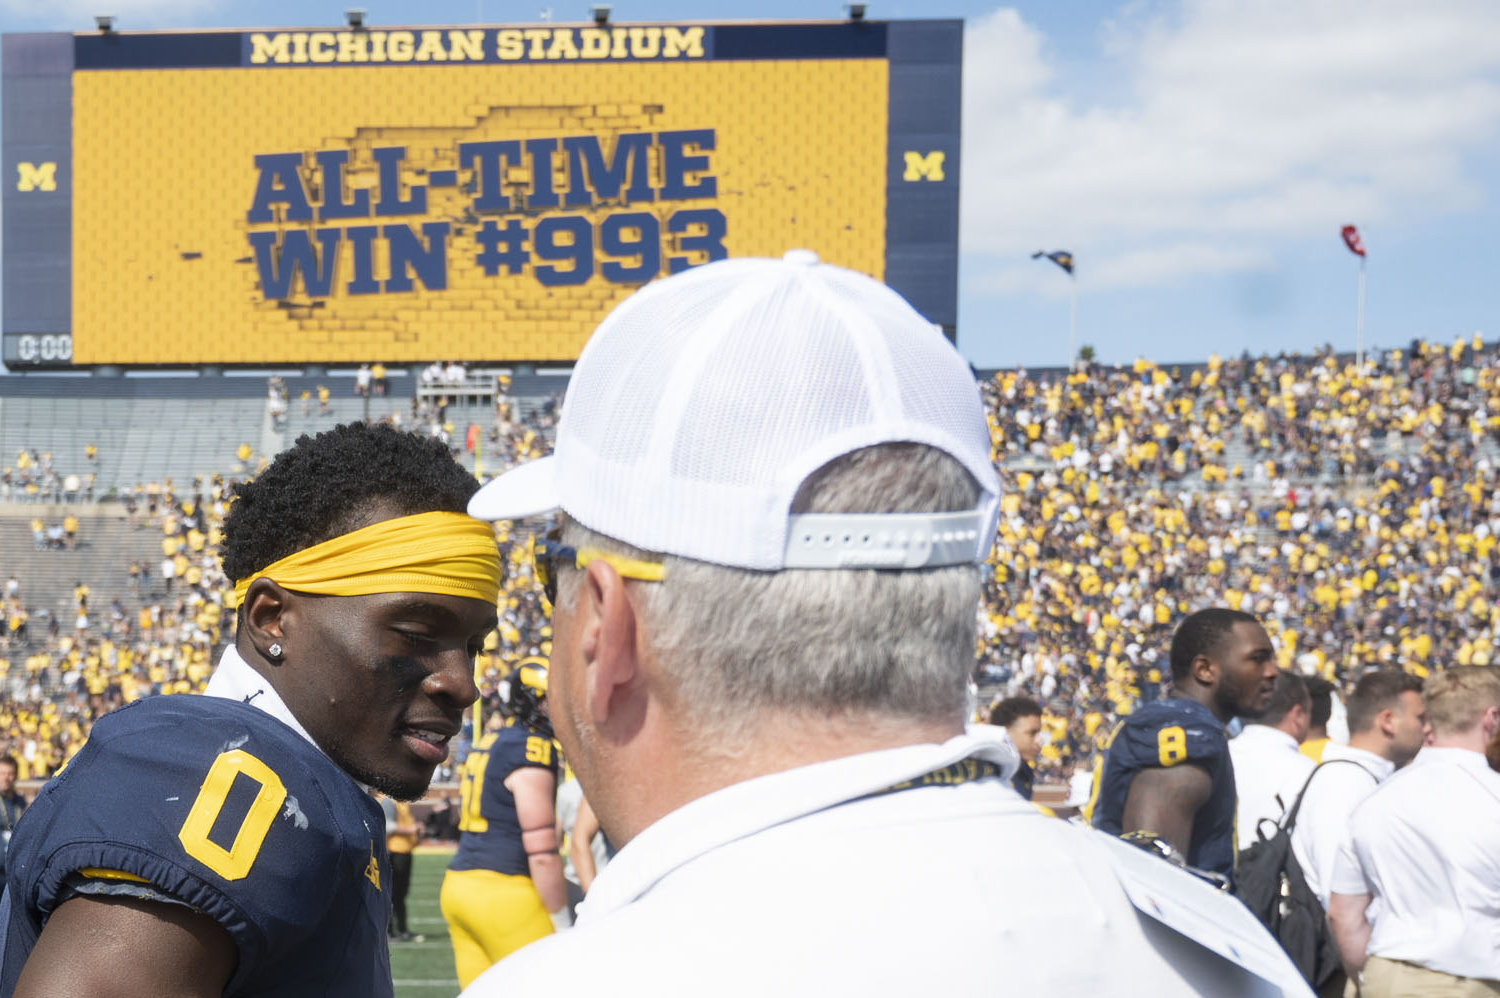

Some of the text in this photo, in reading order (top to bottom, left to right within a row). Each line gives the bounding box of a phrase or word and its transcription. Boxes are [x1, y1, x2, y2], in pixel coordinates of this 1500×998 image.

[250, 27, 705, 64] MICHIGAN STADIUM
[17, 162, 57, 191] M
[247, 129, 717, 224] ALL-TIME
[903, 151, 945, 181] M
[249, 208, 728, 299] WIN #993
[18, 334, 72, 361] 0:00
[525, 735, 552, 766] 51
[1157, 726, 1187, 767] 8
[177, 748, 288, 882] 0
